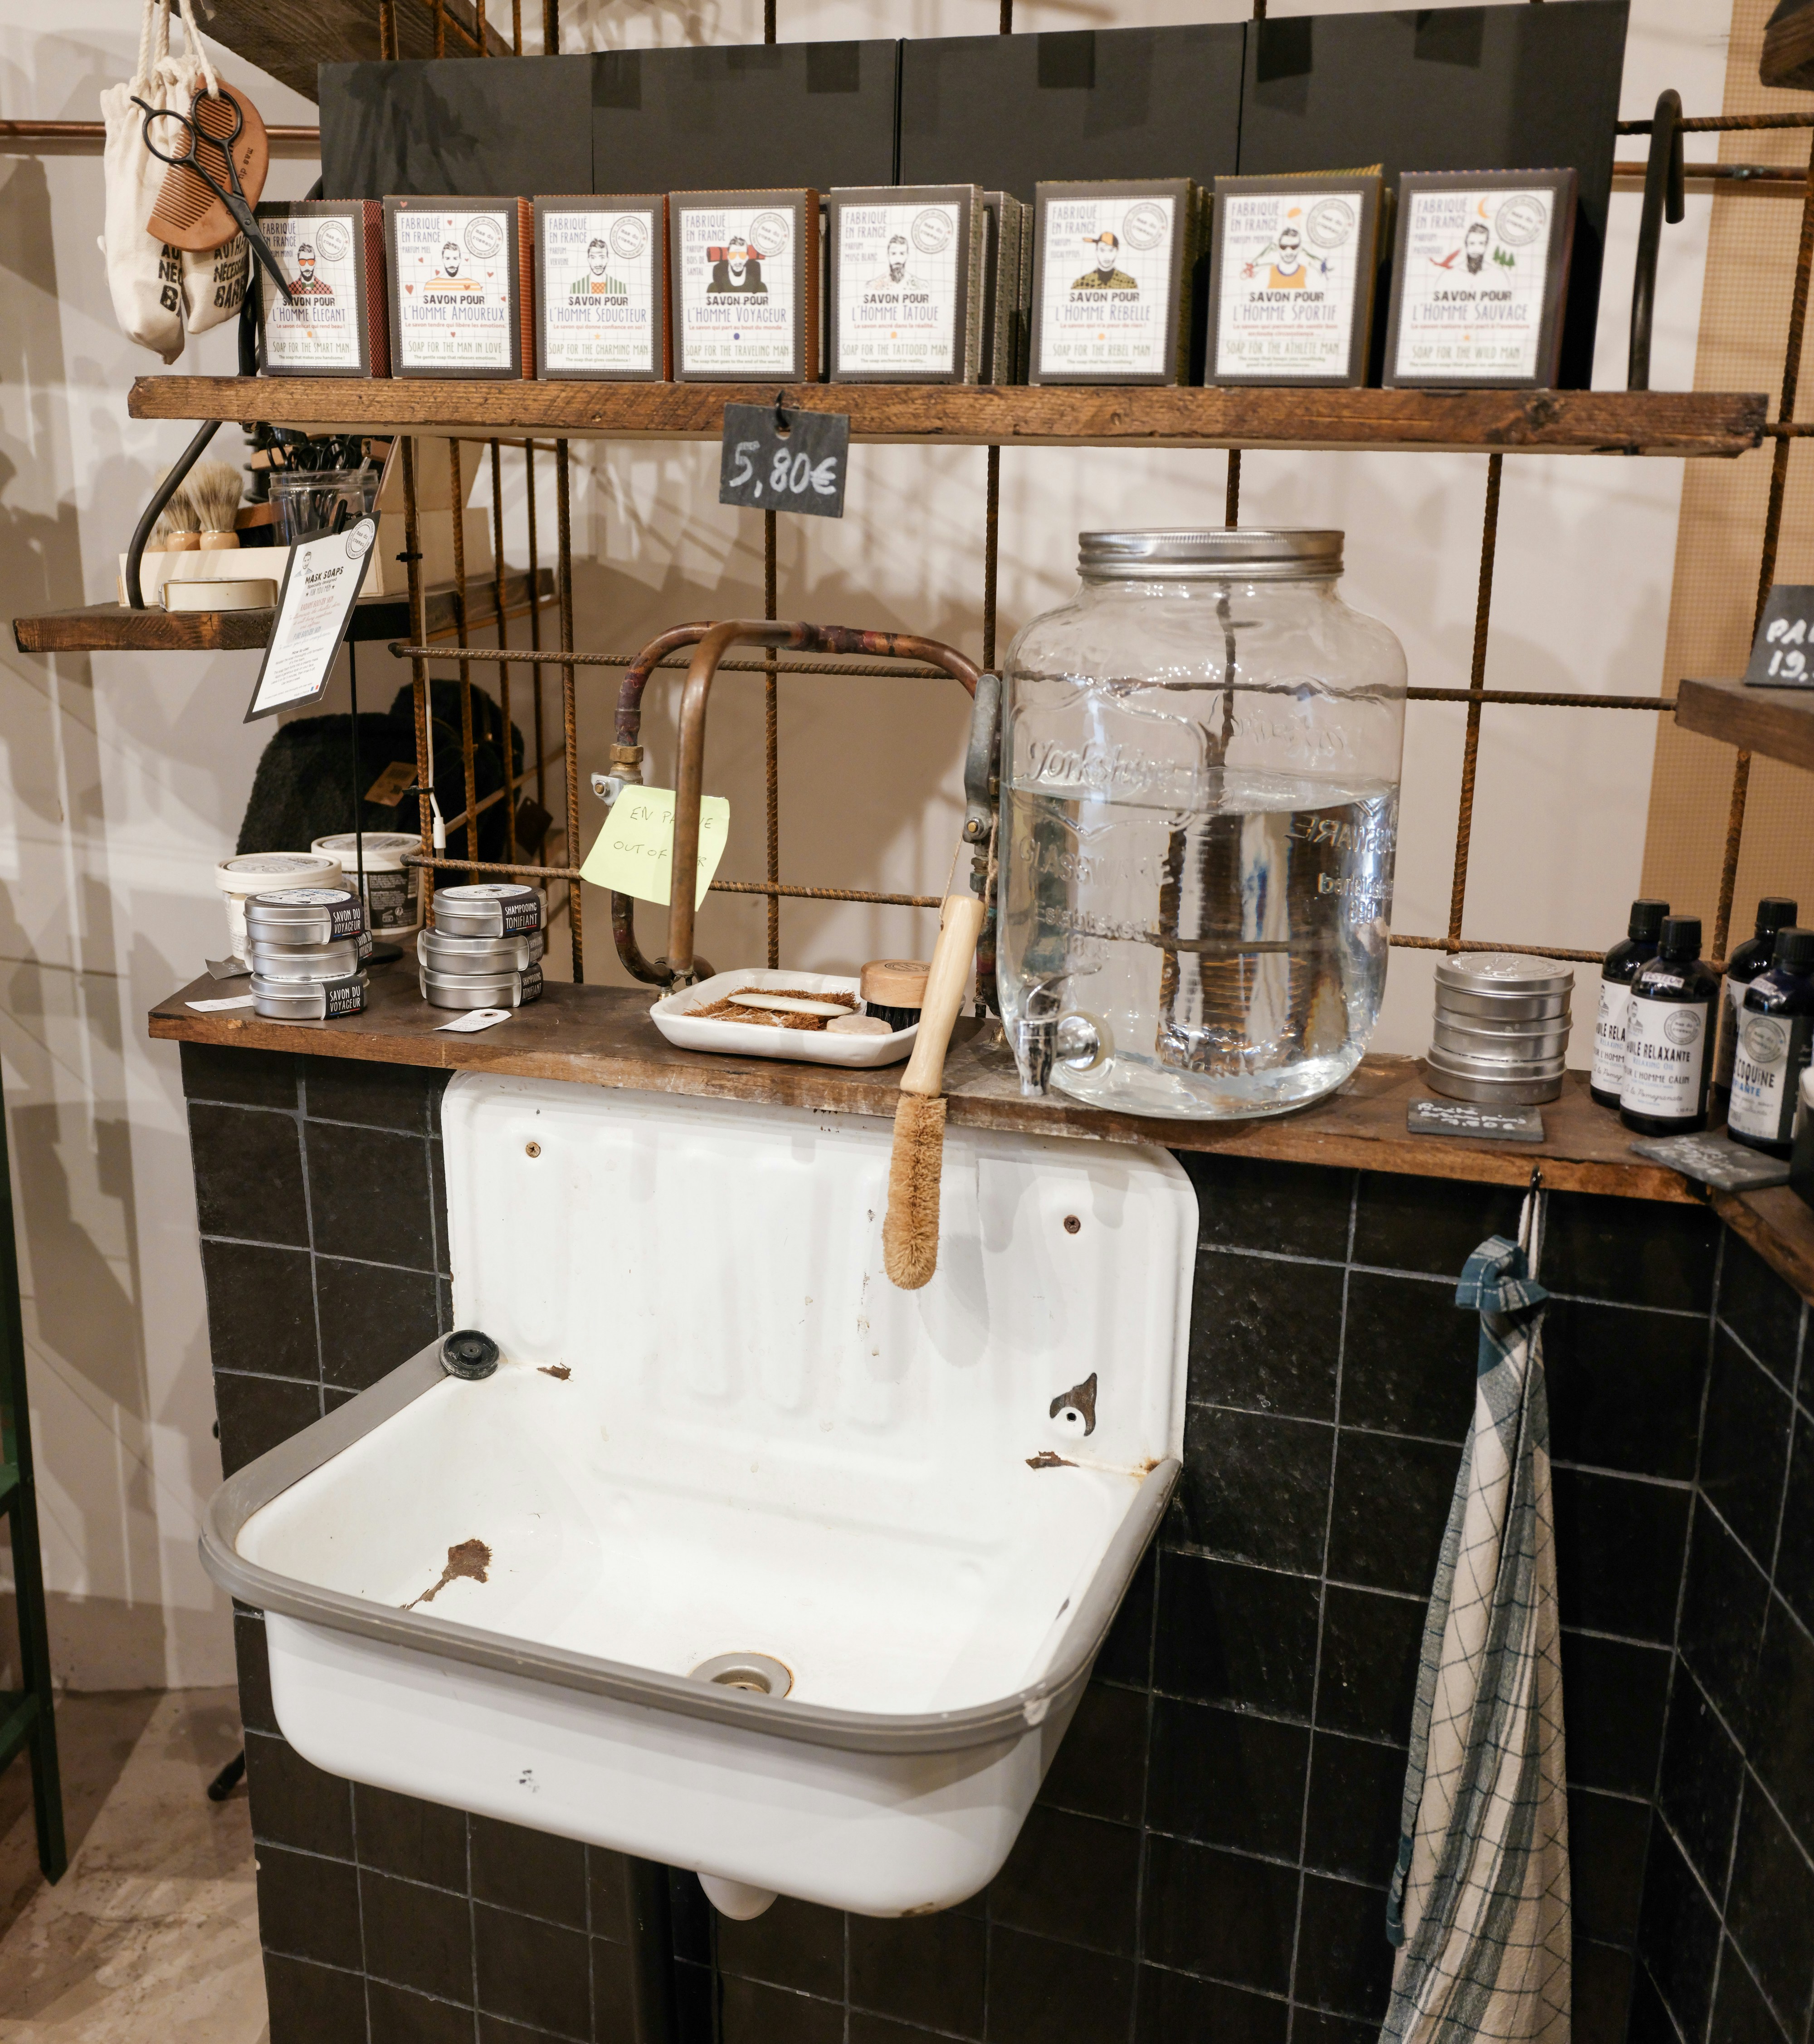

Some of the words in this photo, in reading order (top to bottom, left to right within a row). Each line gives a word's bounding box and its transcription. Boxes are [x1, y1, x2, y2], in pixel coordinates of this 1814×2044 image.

[244, 147, 253, 165] mas
[238, 168, 247, 179] du
[273, 237, 296, 247] FRANCE
[402, 232, 410, 242] EN
[414, 232, 440, 243] FRANCE
[314, 297, 335, 306] POUR
[424, 295, 457, 304] SAVON
[460, 296, 485, 305] POUR
[569, 297, 601, 306] SAVON
[605, 297, 628, 306] POUR
[707, 296, 740, 305] SAVON
[744, 297, 768, 305] POUR
[864, 294, 899, 303] SAVON
[903, 294, 928, 303] POUR
[1070, 292, 1107, 302] SAVON
[1112, 293, 1139, 302] POUR
[1250, 292, 1290, 302] SAVON
[1295, 292, 1324, 302] POUR
[1434, 291, 1476, 302] SAVON
[1481, 291, 1512, 302] POUR
[452, 306, 504, 321] AMOUREUX
[596, 307, 647, 322] SEDUCTEUR
[736, 307, 786, 322] VOYAGEUR
[1111, 304, 1150, 321] REBELLE
[1292, 303, 1336, 321] SPORTIF
[1475, 303, 1527, 321] SAUVAGE
[273, 341, 286, 352] SOAP
[289, 342, 298, 352] FOR
[302, 342, 311, 352] THE
[314, 343, 332, 353] SMART
[336, 343, 349, 353] MAN
[409, 341, 424, 352] SOAP
[428, 342, 439, 352] FOR
[443, 342, 454, 352] THE
[458, 342, 472, 353] MAN
[476, 343, 482, 353] IN
[486, 343, 502, 353] LOVE
[549, 343, 564, 354] SOAP
[567, 344, 578, 355] FOR
[582, 344, 592, 355] THE
[596, 344, 629, 355] CHARMING
[634, 345, 648, 356] MAN
[686, 345, 702, 356] SOAP
[705, 346, 717, 356] FOR
[721, 346, 731, 356] THE
[735, 345, 770, 356] TRAVELING
[773, 346, 789, 356] MAN
[842, 344, 858, 356] SOAP
[861, 344, 873, 356] FOR
[878, 344, 889, 356] THE
[893, 344, 927, 356] TATTOOED
[931, 345, 947, 356] MAN
[1053, 343, 1071, 356] SOAP
[1074, 344, 1087, 356] FOR
[1092, 344, 1104, 356] THE
[1108, 344, 1128, 356] REBEL
[1133, 344, 1151, 356] MAN
[1226, 341, 1245, 354] SOAP
[1249, 341, 1263, 354] FOR
[1268, 341, 1280, 354] THE
[1321, 342, 1338, 355] MAN
[729, 441, 838, 498] 5,80€
[352, 538, 364, 546] roseau
[305, 572, 322, 585] MASK
[323, 566, 343, 579] SOAPS
[630, 806, 653, 820] EN
[614, 841, 644, 854] OUT
[648, 849, 667, 859] OF
[333, 909, 351, 922] SAVON
[353, 908, 360, 919] DU
[505, 902, 536, 915] SHAMPOOING
[335, 920, 361, 933] VOYAGEUR
[506, 913, 537, 929] TONIFIANT
[356, 933, 367, 946] SAVON
[366, 931, 371, 942] DU
[529, 936, 542, 949] SHAMPOOING
[359, 942, 372, 957] VOYAGEUR
[530, 946, 543, 962] TONIFIANT
[523, 972, 541, 986] SHAMPOOING
[330, 988, 349, 1002] SAVON
[352, 985, 360, 996] DU
[522, 983, 541, 999] TONIFIANT
[330, 997, 360, 1012] VOYAGEUR
[1643, 1044, 1690, 1062] RELAXANTE
